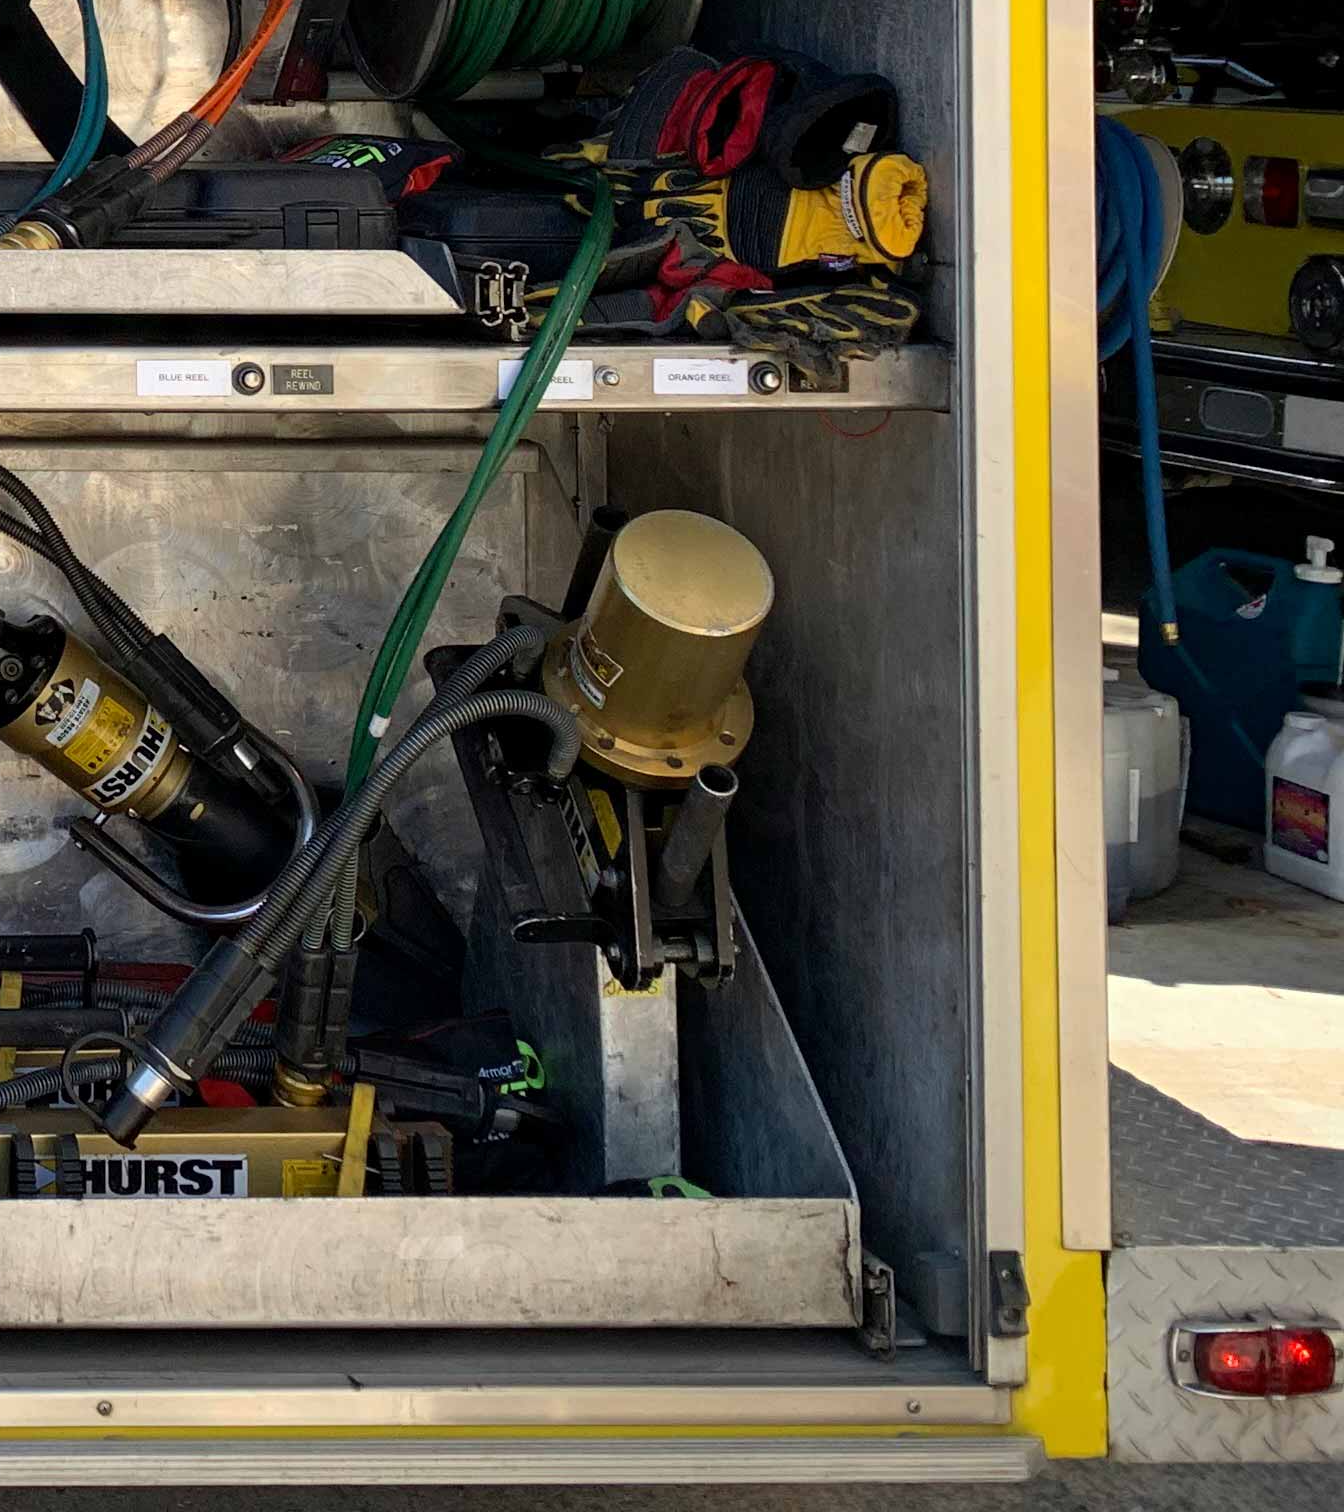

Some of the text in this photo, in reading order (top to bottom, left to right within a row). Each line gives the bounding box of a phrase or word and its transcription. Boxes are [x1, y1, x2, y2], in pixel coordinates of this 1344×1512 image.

[158, 373, 209, 382] BLUE REEL
[290, 369, 314, 379] REEL
[667, 373, 732, 382] ORANGE REEL
[285, 381, 321, 391] REWIND
[91, 724, 165, 804] HURST
[81, 1159, 243, 1196] HURST
